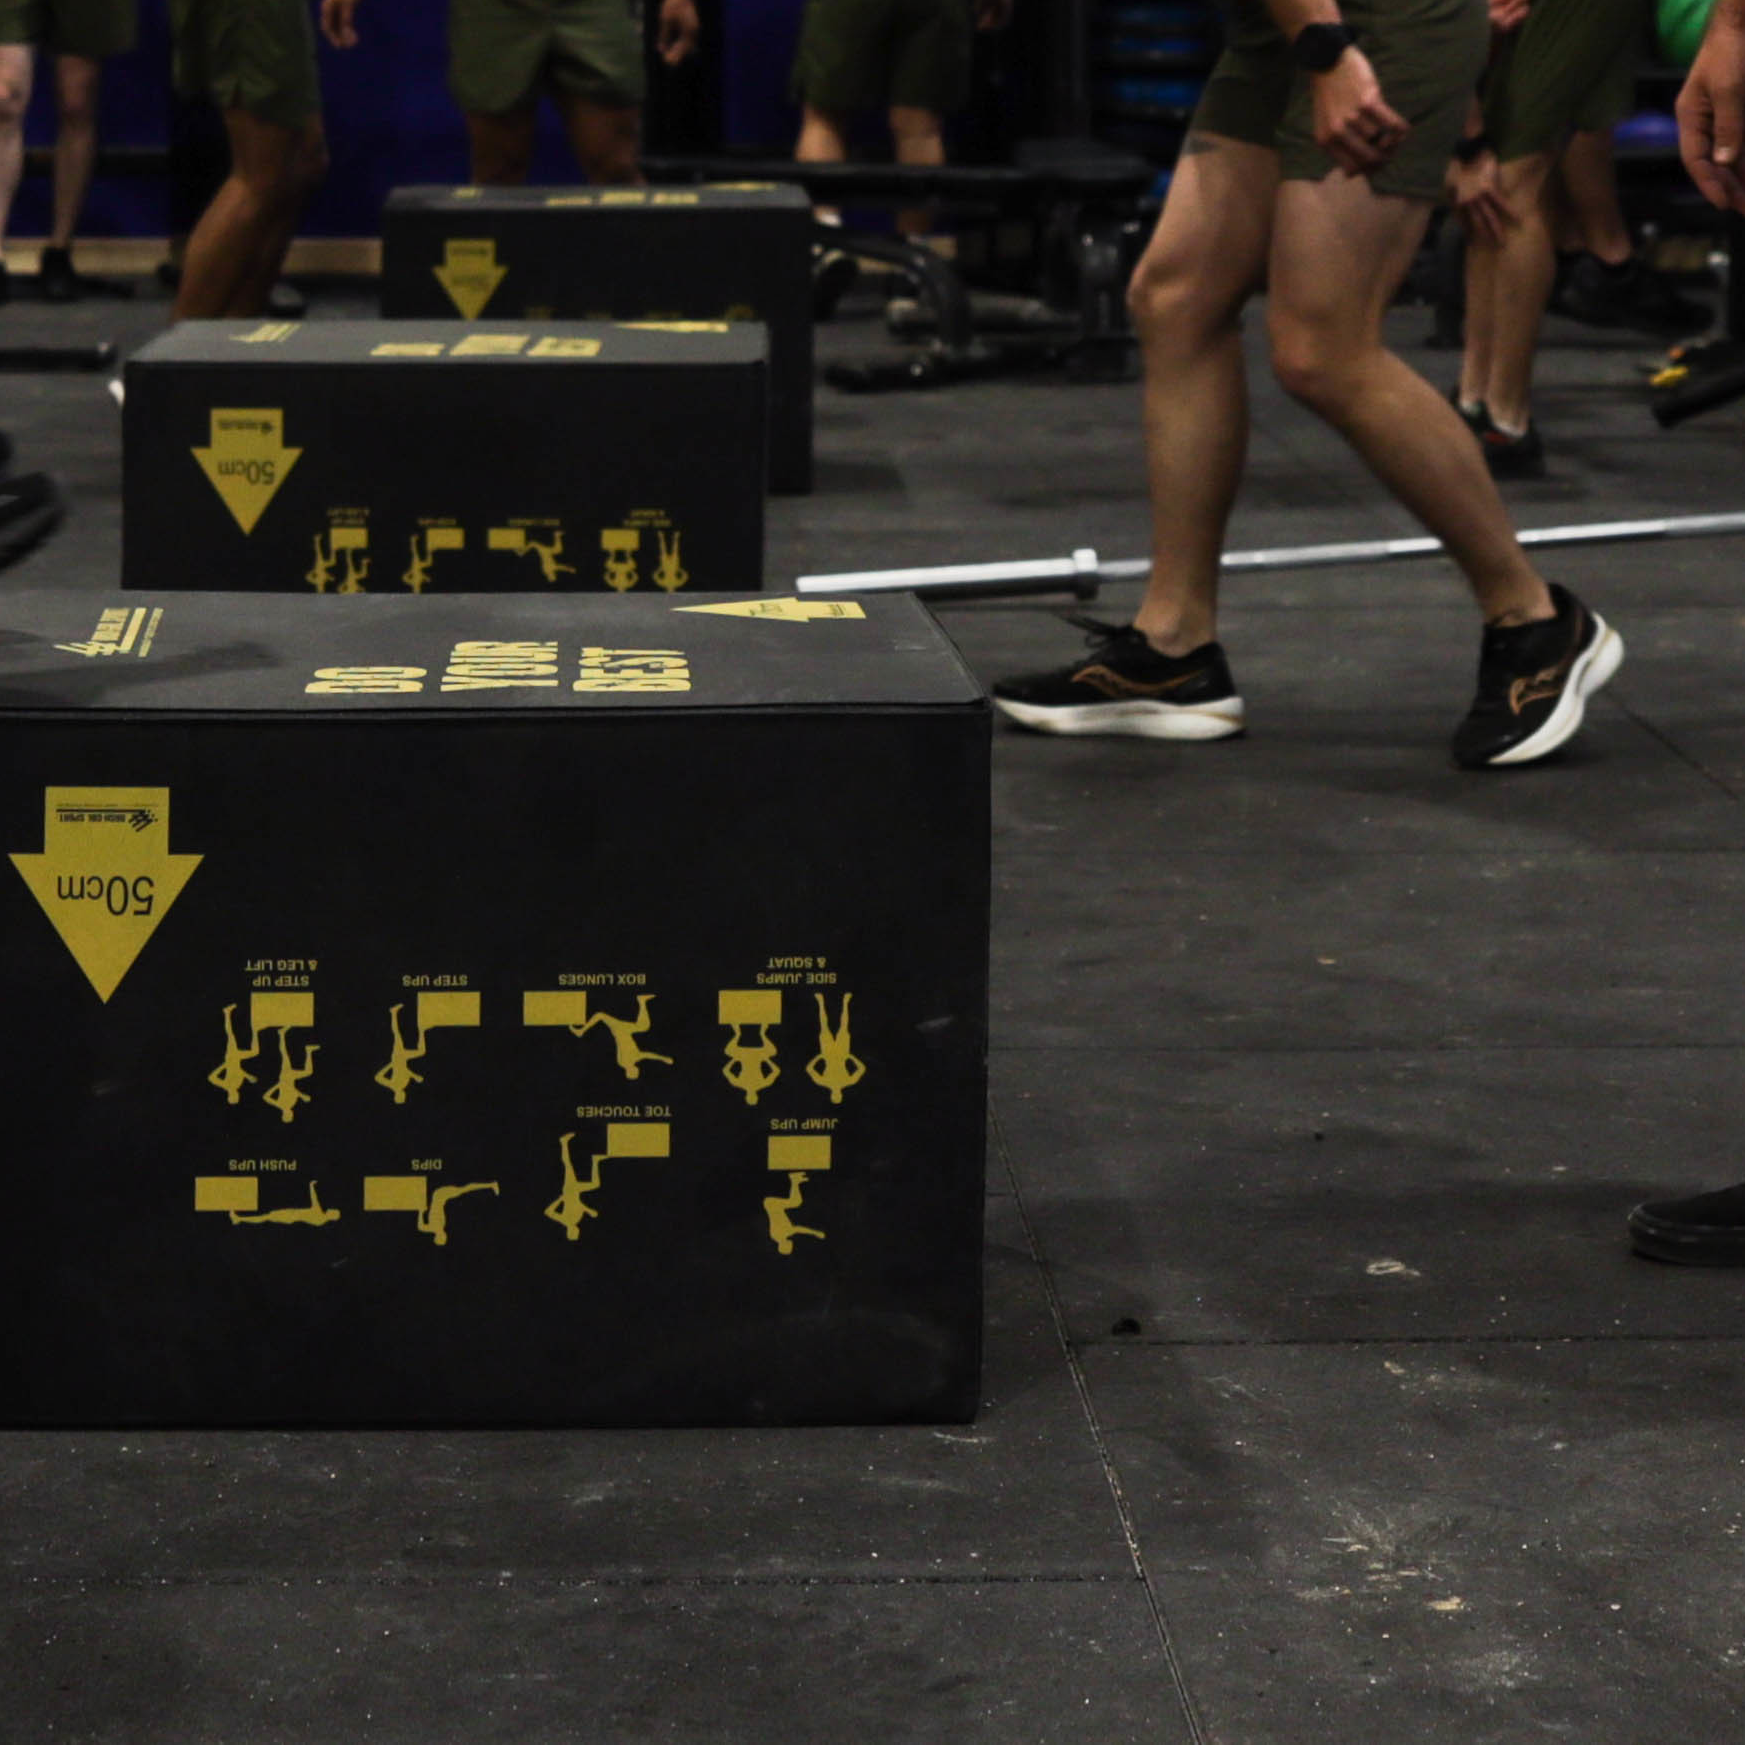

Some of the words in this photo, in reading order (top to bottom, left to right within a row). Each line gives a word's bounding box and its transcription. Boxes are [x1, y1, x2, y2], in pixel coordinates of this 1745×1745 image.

[217, 460, 275, 484] 50cm
[57, 875, 155, 916] 50cm
[246, 960, 273, 971] LIFT
[277, 960, 304, 971] LEG
[308, 960, 318, 971] &
[767, 957, 813, 968] SQUAT
[817, 958, 826, 968] &
[253, 976, 271, 986] UP
[275, 976, 309, 986] STEP
[403, 975, 429, 986] UPS
[433, 975, 467, 986] STEP
[559, 974, 613, 985] LUNGES
[618, 974, 646, 985] BOX
[757, 973, 802, 984] JUMPS
[807, 973, 836, 984] SIDE
[577, 1106, 640, 1117] TOUCHES
[646, 1106, 671, 1117] TOE
[771, 1119, 797, 1129] UPS
[801, 1118, 838, 1129] JUMP
[229, 1160, 255, 1170] UPS
[260, 1160, 296, 1170] PUSH
[412, 1159, 442, 1170] DIPS
